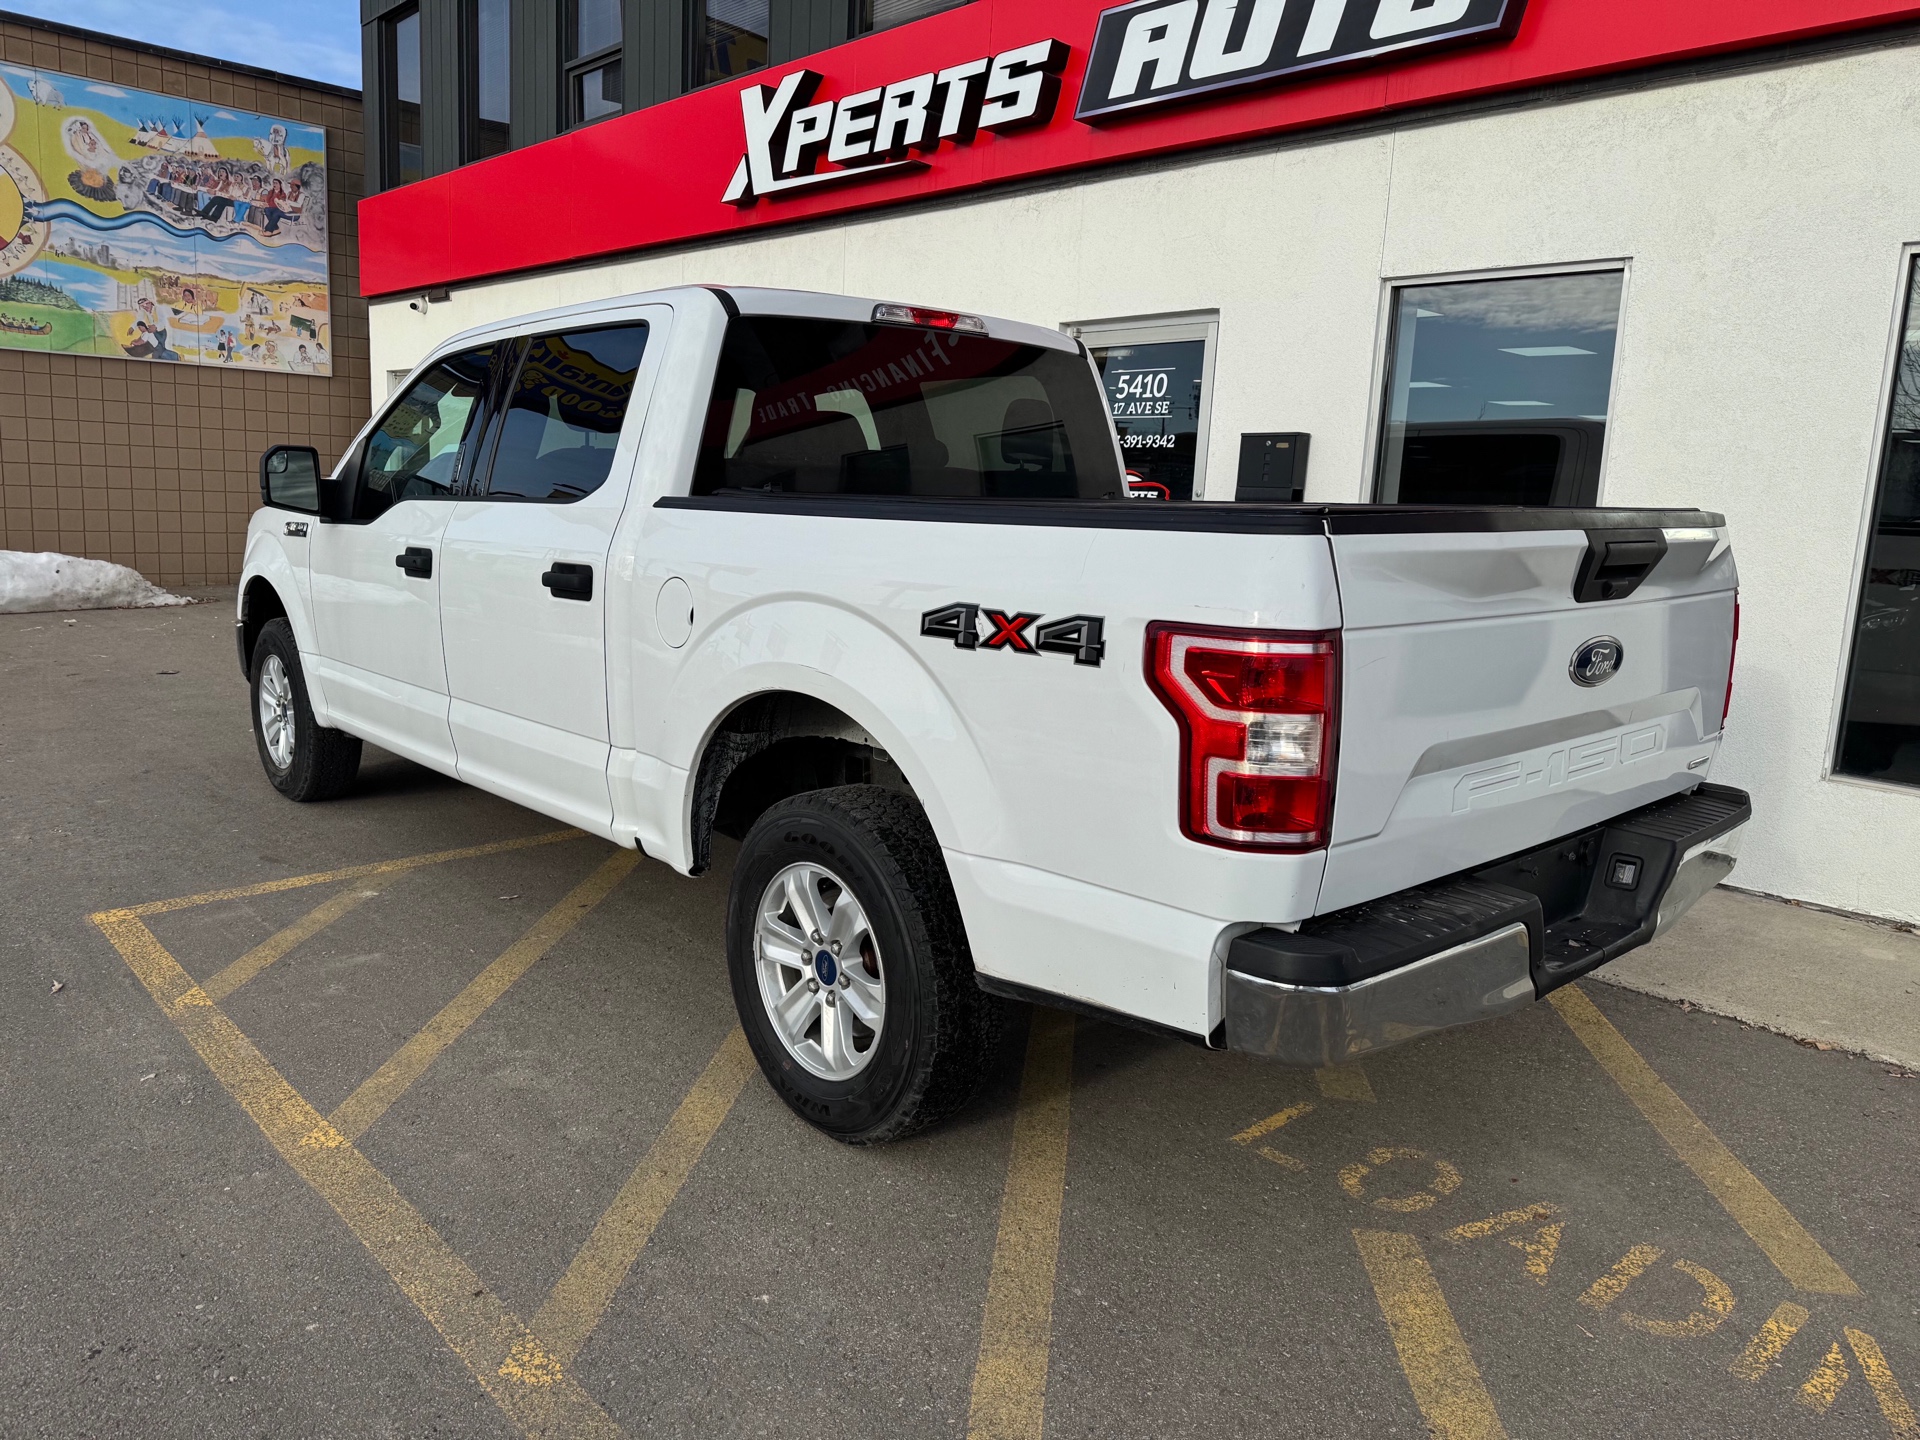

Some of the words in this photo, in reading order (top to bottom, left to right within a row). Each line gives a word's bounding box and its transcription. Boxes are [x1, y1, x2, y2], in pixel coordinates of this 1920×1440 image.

[720, 38, 1058, 204] XPERTS
[1113, 402, 1125, 414] 17
[1127, 402, 1153, 414] AVE
[1155, 401, 1171, 413] SE
[1115, 373, 1168, 398] 5410
[1452, 724, 1667, 815] F-150
